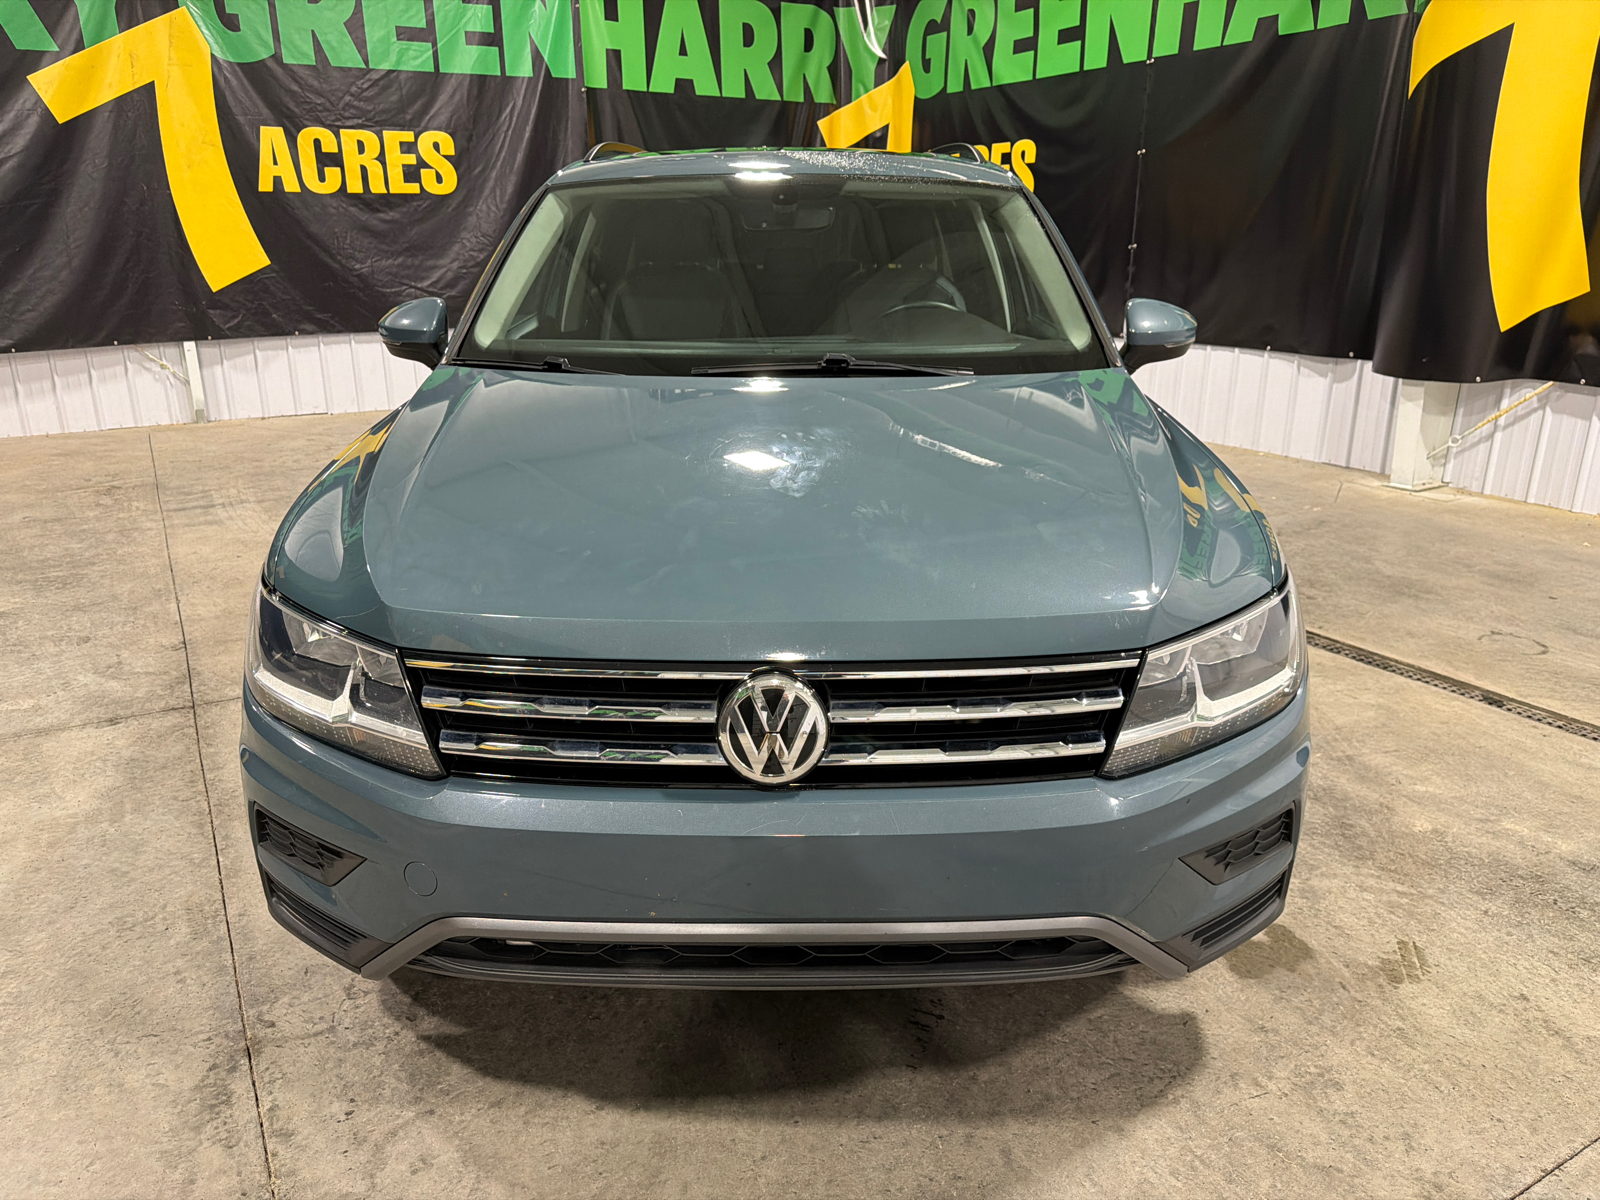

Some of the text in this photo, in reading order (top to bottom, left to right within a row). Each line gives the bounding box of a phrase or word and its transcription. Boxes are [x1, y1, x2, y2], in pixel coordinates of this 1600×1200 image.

[178, 0, 577, 79] GREEN
[580, 0, 896, 105] HARRY
[906, 0, 1152, 99] GREEN
[27, 6, 458, 292] 7 ACRES
[1408, 0, 1600, 332] 7
